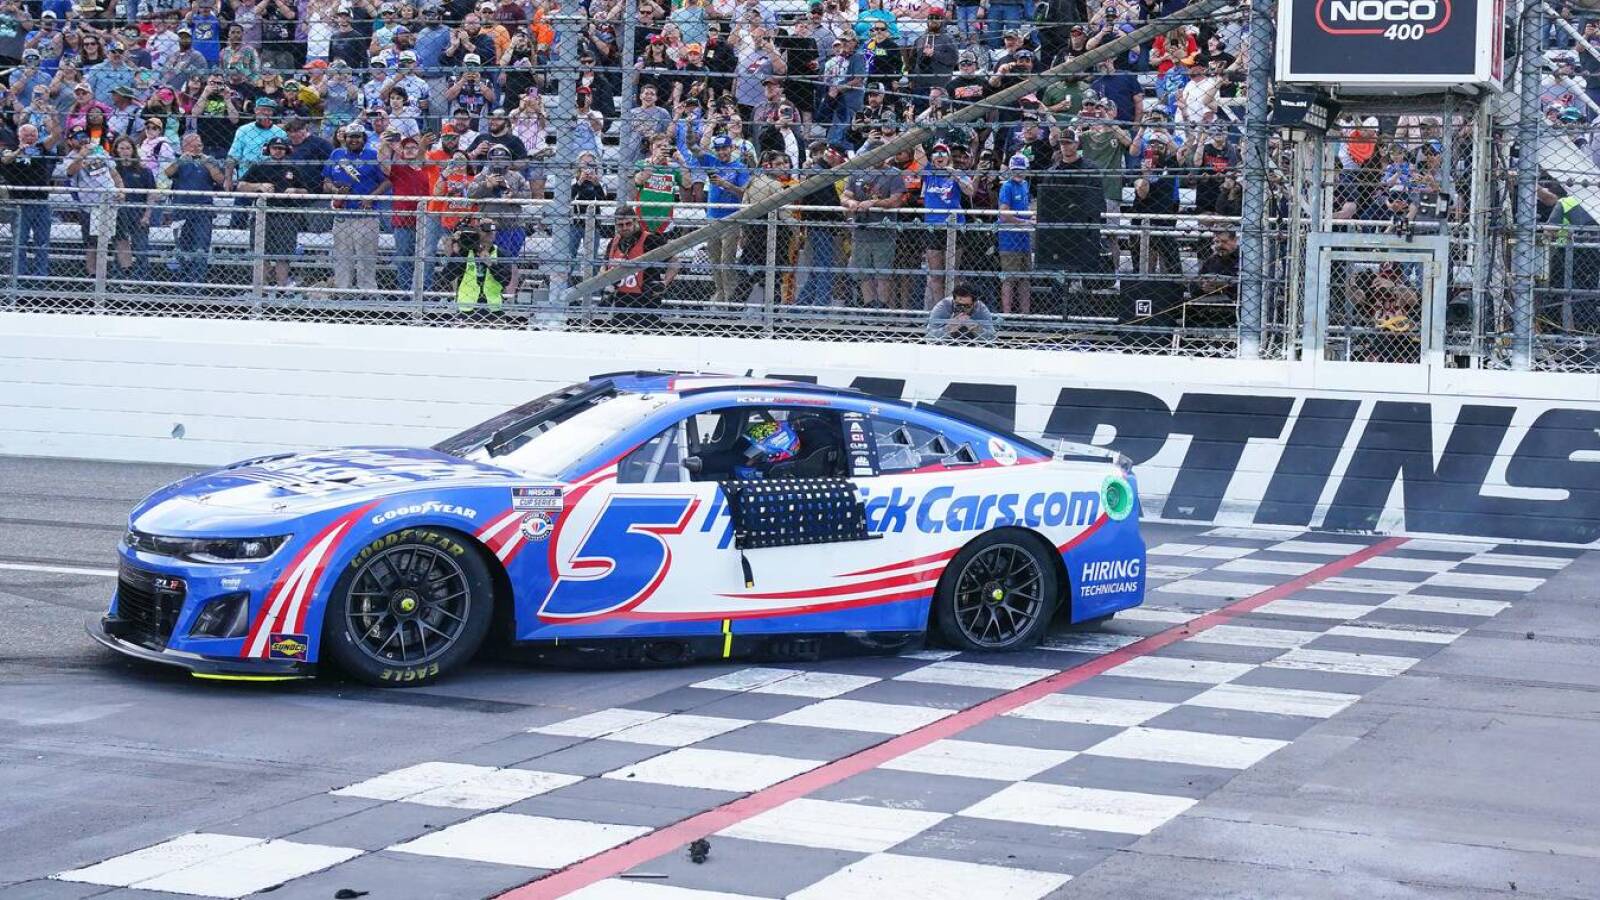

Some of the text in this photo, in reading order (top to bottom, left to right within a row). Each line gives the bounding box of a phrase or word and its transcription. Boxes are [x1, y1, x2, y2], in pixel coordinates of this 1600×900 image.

[1330, 0, 1436, 21] NOCO
[1384, 24, 1425, 40] 400
[519, 498, 557, 506] CUP SERIES
[371, 501, 478, 524] GOODYEAR
[351, 529, 464, 568] GOODYEAR
[537, 492, 700, 624] 5
[1081, 558, 1140, 582] HIRING
[1080, 581, 1138, 597] TECHNICIANS
[271, 642, 307, 652] SUNOCO
[379, 662, 440, 682] EAGLE
